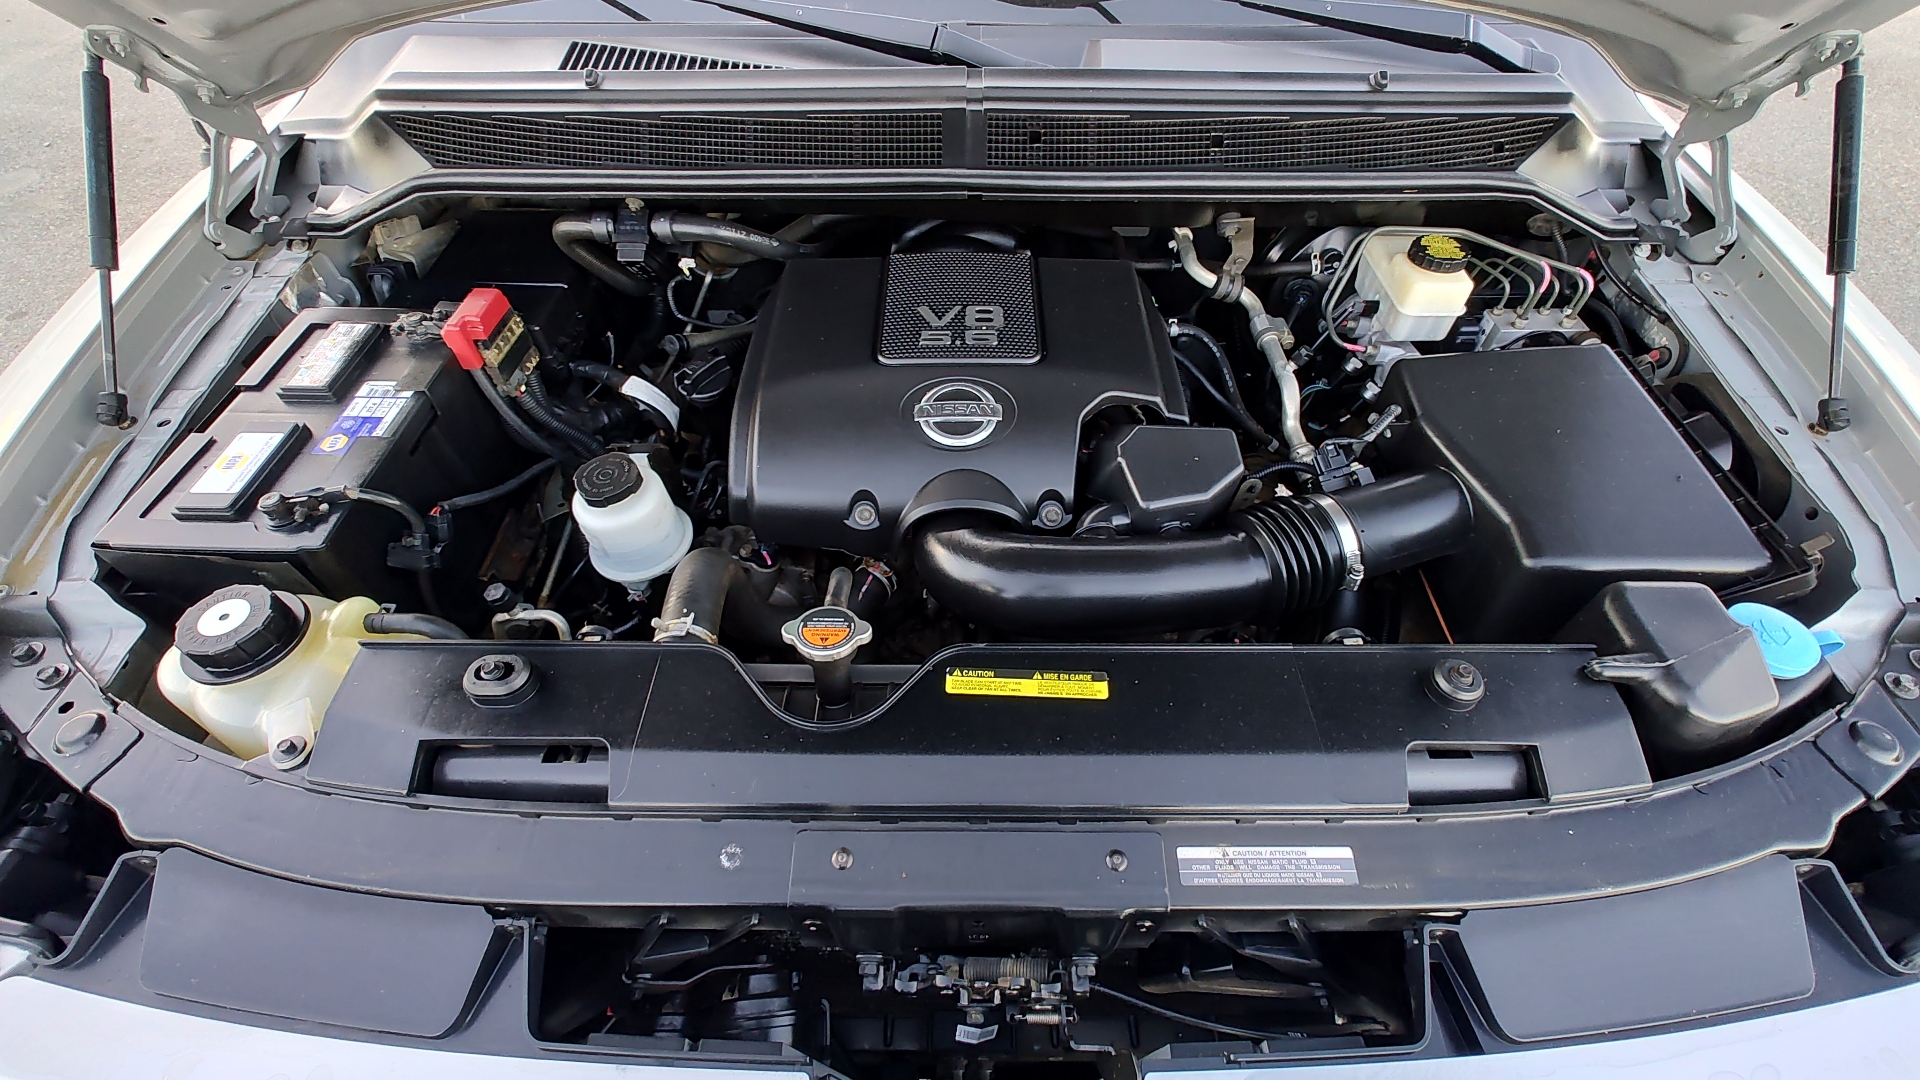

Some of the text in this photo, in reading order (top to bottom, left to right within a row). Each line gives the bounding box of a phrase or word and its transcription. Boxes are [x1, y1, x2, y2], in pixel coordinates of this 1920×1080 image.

[916, 305, 1005, 328] V8
[919, 330, 998, 346] 5.6
[922, 404, 994, 416] NISSAN
[221, 455, 244, 470] NAPA
[962, 669, 995, 678] CAUTION
[1043, 672, 1059, 680] MISE
